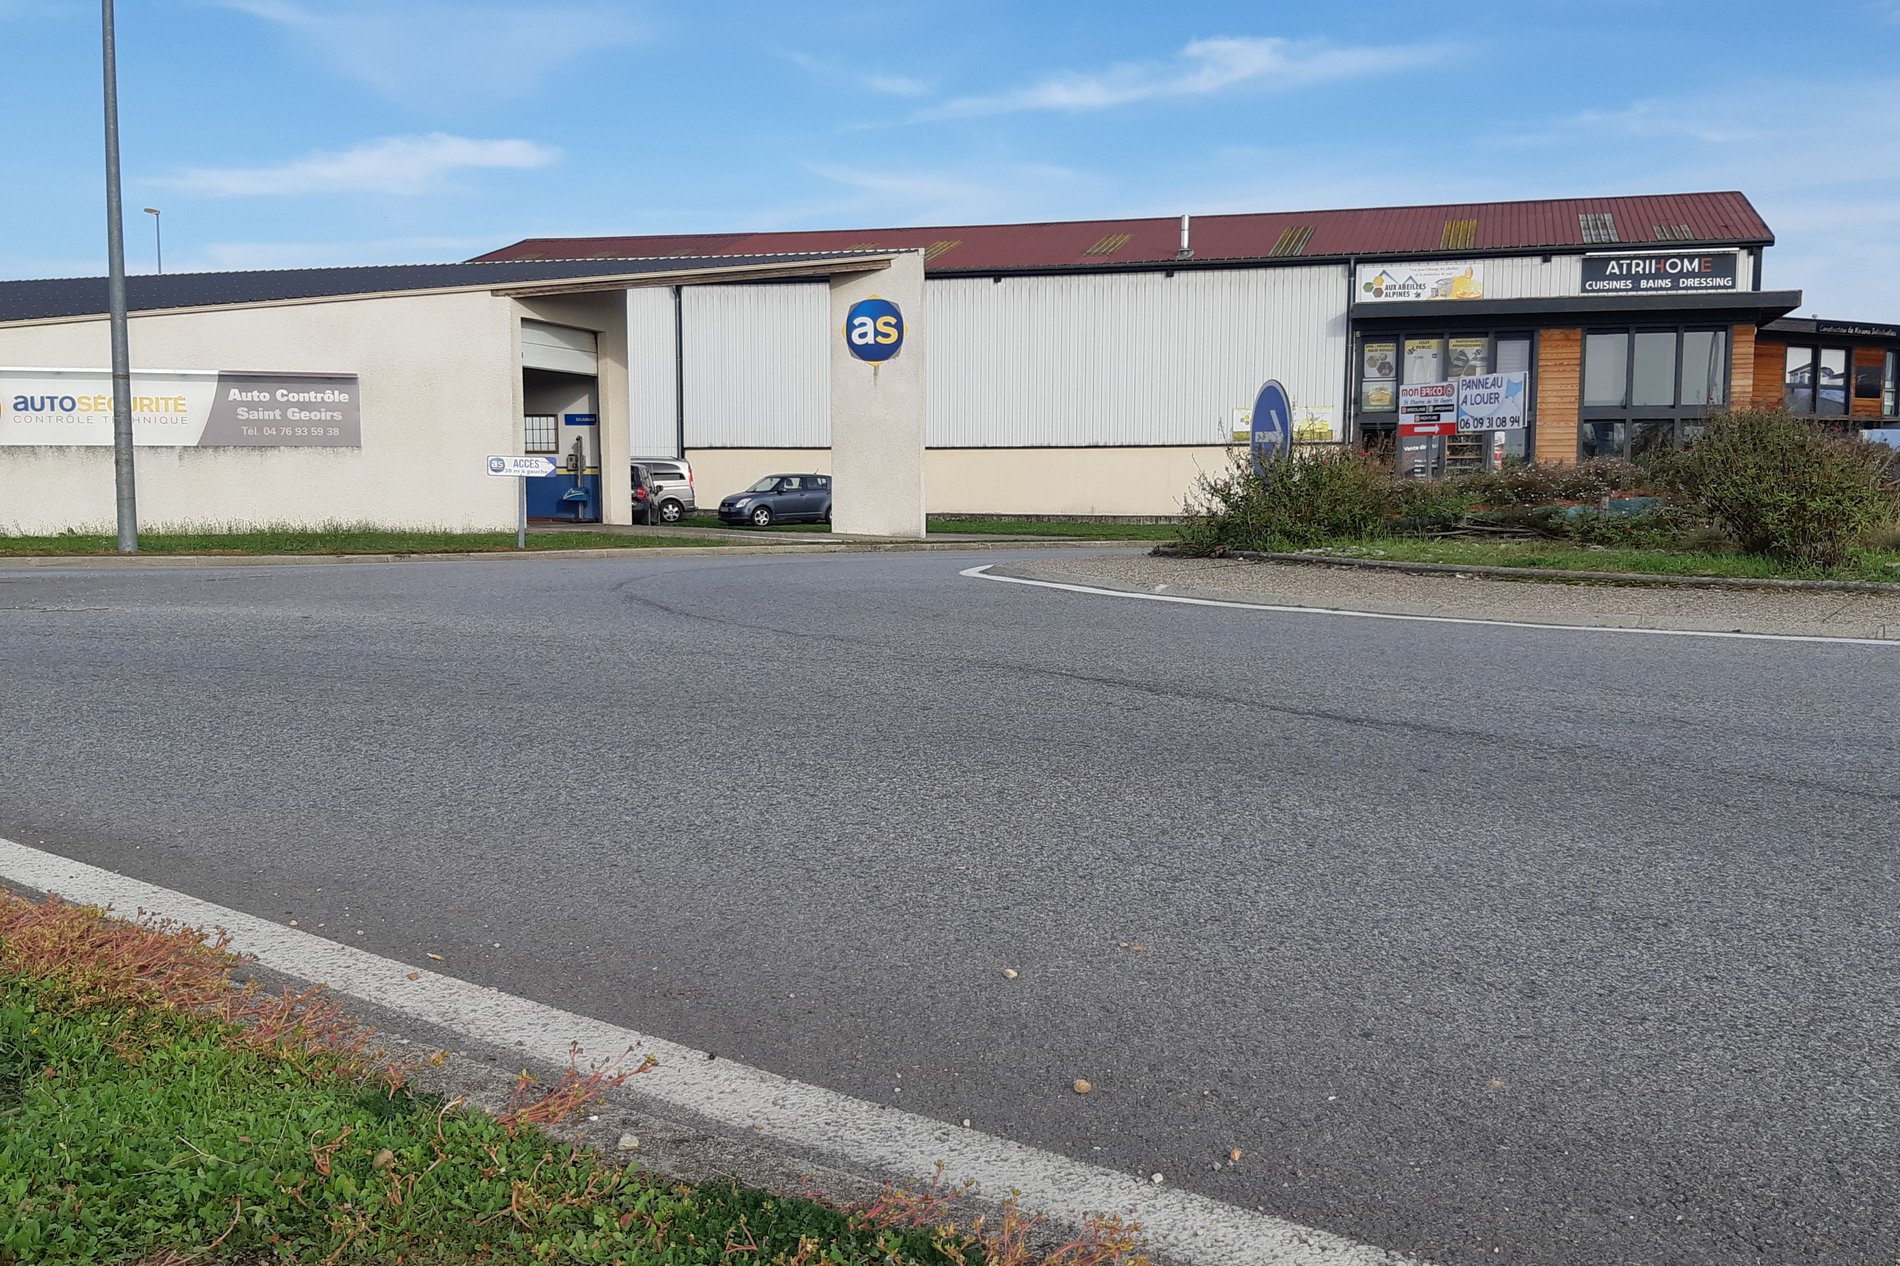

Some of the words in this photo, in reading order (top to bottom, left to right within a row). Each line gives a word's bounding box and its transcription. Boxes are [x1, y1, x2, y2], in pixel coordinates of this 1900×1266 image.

[1586, 280, 1632, 290] CUISINES
[1640, 279, 1672, 289] BAINS
[1679, 277, 1733, 287] DRESSING
[851, 315, 899, 345] as
[1461, 377, 1503, 391] PANNEAU
[228, 388, 270, 401] Auto
[276, 389, 350, 402] Contrôle
[1461, 394, 1468, 406] A
[1470, 392, 1500, 406] LOUER
[13, 413, 94, 424] CONTRÔLE
[103, 415, 188, 425] THNIQUE
[237, 406, 282, 420] Saint
[287, 407, 343, 421] Geoirs
[1460, 418, 1471, 429] 06
[1473, 417, 1484, 429] 09
[1486, 416, 1494, 428] 31
[1495, 416, 1507, 428] 08
[1509, 415, 1520, 427] 94
[241, 426, 260, 436] Tél.
[263, 427, 276, 436] 04
[280, 427, 292, 436] 76
[295, 427, 308, 436] 93
[311, 427, 324, 436] 59
[327, 427, 340, 436] 38
